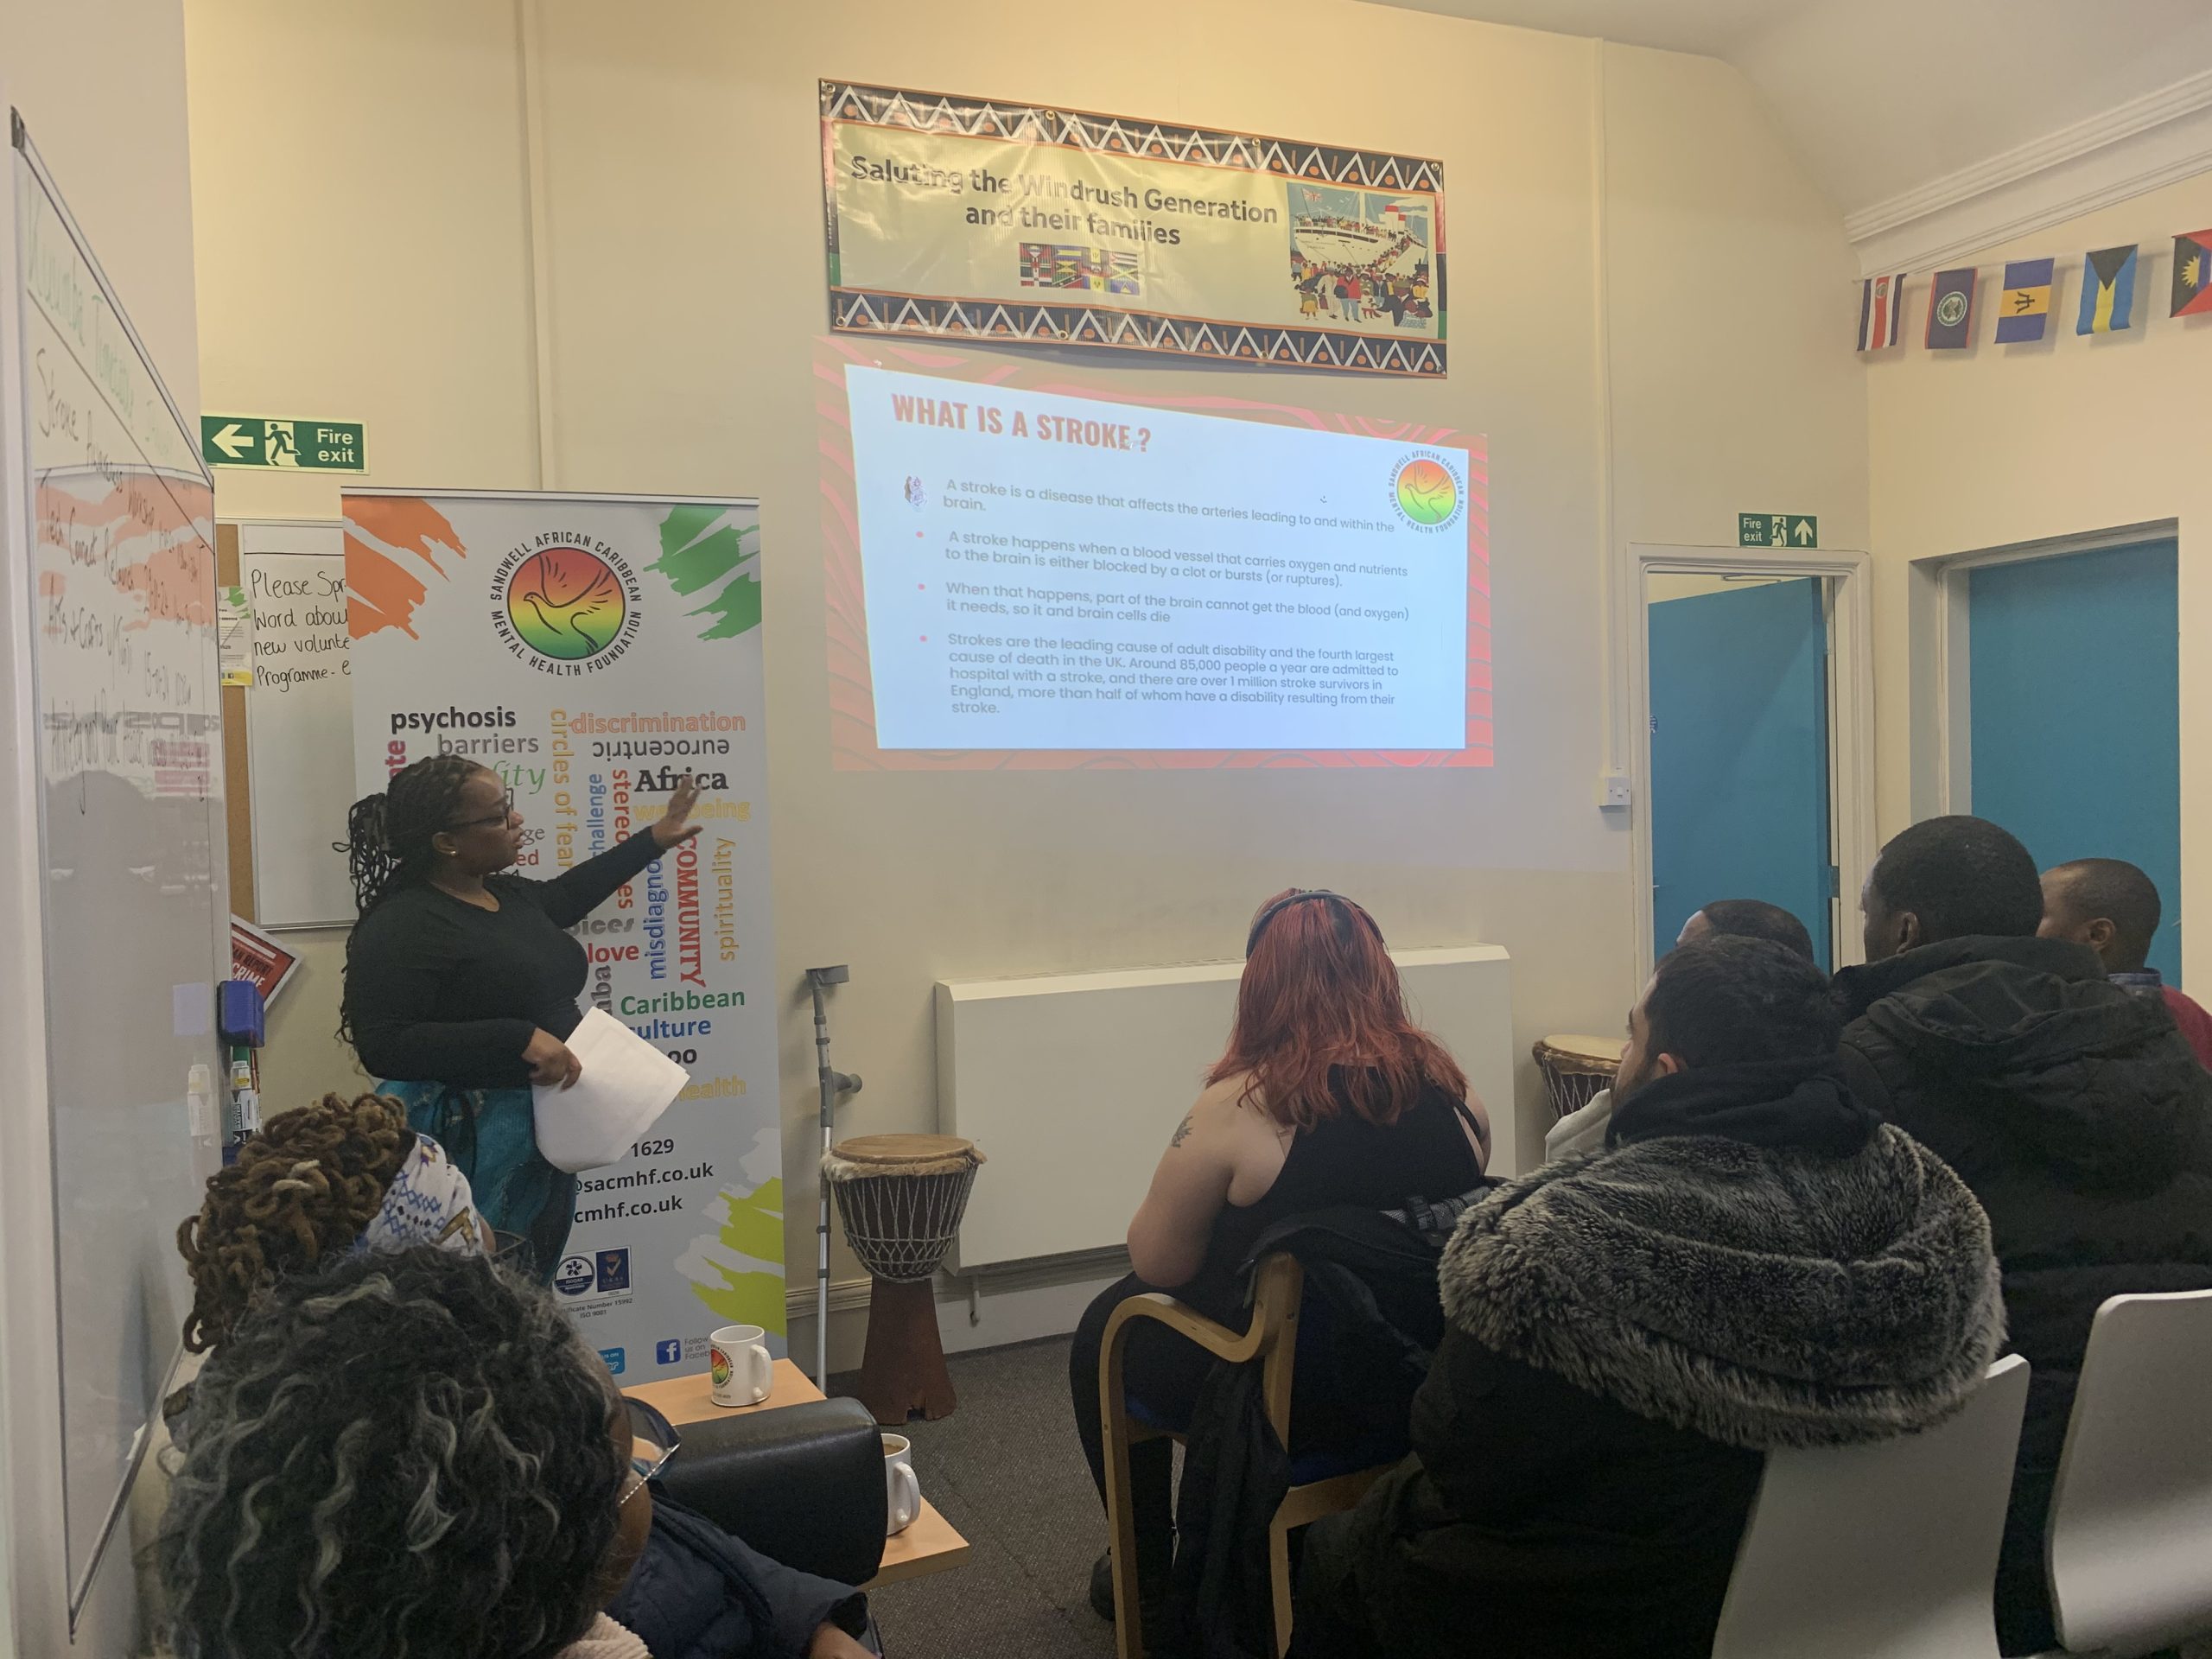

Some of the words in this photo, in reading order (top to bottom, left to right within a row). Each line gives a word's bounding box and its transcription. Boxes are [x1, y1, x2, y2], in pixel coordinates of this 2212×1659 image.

[851, 156, 963, 194] Saluting
[970, 168, 1012, 194] the
[1019, 174, 1138, 208] Windrush
[1144, 188, 1278, 224] Generation
[966, 206, 1014, 226] and
[1020, 207, 1082, 231] their
[1087, 213, 1181, 245] families
[891, 393, 969, 430] WHAT
[977, 405, 1003, 435] IS
[1012, 410, 1029, 438] A
[1037, 414, 1131, 451] STROKE
[1137, 427, 1151, 452] ?
[317, 428, 353, 445] Fire
[318, 448, 354, 463] exit
[1389, 454, 1410, 486] SANDWELL
[1412, 450, 1440, 461] AFRICAN
[1441, 458, 1464, 494] CARIBBEAN
[944, 496, 986, 512] brain.
[946, 478, 957, 490] A
[960, 480, 1007, 495] stroke
[1010, 485, 1022, 497] is
[1026, 489, 1035, 499] a
[1039, 487, 1093, 505] disease
[1096, 493, 1124, 508] that
[1128, 498, 1174, 513] affects
[1178, 502, 1198, 515] the
[1201, 505, 1249, 520] arteries
[1251, 509, 1296, 528] leading
[1299, 513, 1312, 525] to
[1314, 516, 1337, 528] and
[1340, 517, 1373, 531] within
[1376, 519, 1395, 532] the
[1389, 492, 1406, 522] MENTAL
[1406, 519, 1433, 533] HEALTH
[1743, 518, 1762, 529] Fire
[1744, 531, 1762, 542] exit
[490, 543, 532, 601] SANDWELL
[535, 531, 592, 548] AFRICAN
[594, 541, 642, 602] CARIBBEAN
[949, 530, 959, 542] A
[963, 531, 1008, 547] stroke
[1012, 536, 1076, 554] happens
[1079, 543, 1116, 556] when
[1121, 548, 1129, 557] a
[1134, 546, 1171, 560] blood
[1174, 551, 1213, 563] vessel
[1217, 552, 1241, 565] that
[1244, 556, 1286, 569] carries
[1288, 560, 1331, 574] oxygen
[1333, 562, 1356, 574] and
[1359, 563, 1408, 577] nutrients
[945, 548, 961, 560] to
[964, 549, 988, 563] the
[994, 551, 1030, 565] brain
[1035, 554, 1046, 566] is
[1049, 556, 1090, 569] either
[1093, 558, 1147, 574] blocked
[1151, 563, 1166, 578] by
[1171, 566, 1179, 575] a
[1182, 565, 1206, 578] clot
[1210, 569, 1221, 579] or
[1225, 568, 1262, 582] bursts
[1266, 570, 1283, 586] (or
[1286, 573, 1343, 590] ruptures).
[251, 569, 309, 599] Please
[317, 570, 346, 602] Spr
[946, 582, 989, 596] When
[994, 585, 1023, 598] that
[1027, 587, 1093, 605] happens,
[1096, 593, 1124, 607] part
[1128, 594, 1141, 606] of
[1145, 594, 1166, 607] the
[1170, 595, 1203, 609] brain
[1205, 600, 1249, 612] cannot
[1252, 601, 1272, 616] get
[1275, 601, 1294, 614] the
[1298, 603, 1331, 616] blood
[1334, 605, 1361, 620] (and
[1364, 607, 1408, 623] oxygen)
[253, 608, 297, 631] Word
[254, 641, 286, 656] new
[491, 610, 526, 659] MENTAL
[529, 655, 581, 676] HEALTH
[587, 611, 641, 673] FOUNDATION
[948, 632, 1002, 647] Strokes
[1006, 638, 1030, 648] are
[1034, 637, 1058, 650] the
[1061, 638, 1113, 656] leading
[1116, 643, 1157, 654] cause
[1162, 643, 1173, 655] of
[1177, 643, 1210, 656] adult
[1212, 644, 1266, 661] disability
[1269, 646, 1293, 658] and
[1296, 646, 1315, 659] the
[1318, 647, 1352, 660] fourth
[1355, 649, 1394, 664] largest
[949, 653, 995, 664] cause
[999, 652, 1013, 664] of
[1016, 652, 1058, 665] death
[1063, 654, 1075, 666] in
[1079, 654, 1102, 667] the
[1105, 655, 1125, 668] UK.
[1129, 656, 1176, 670] Around
[1179, 658, 1221, 673] 85,000
[1224, 660, 1266, 676] people
[1269, 664, 1277, 673] a
[1281, 664, 1306, 677] year
[1310, 664, 1329, 675] are
[1332, 663, 1384, 677] admitted
[1387, 664, 1398, 677] to
[391, 705, 517, 734] psychosis
[952, 701, 1000, 714] stroke.
[570, 711, 746, 734] discrimination
[438, 733, 539, 755] barriers
[550, 708, 575, 785] circles
[592, 739, 730, 762] eurocentric
[554, 791, 577, 816] of
[556, 823, 578, 870] fear
[676, 836, 707, 988] COMMUNITY
[712, 837, 740, 962] spirituality
[588, 943, 640, 963] love
[620, 990, 746, 1016] Caribbean
[627, 1019, 712, 1039] ulture
[631, 1138, 675, 1158] 1629
[588, 1301, 613, 1310] Number
